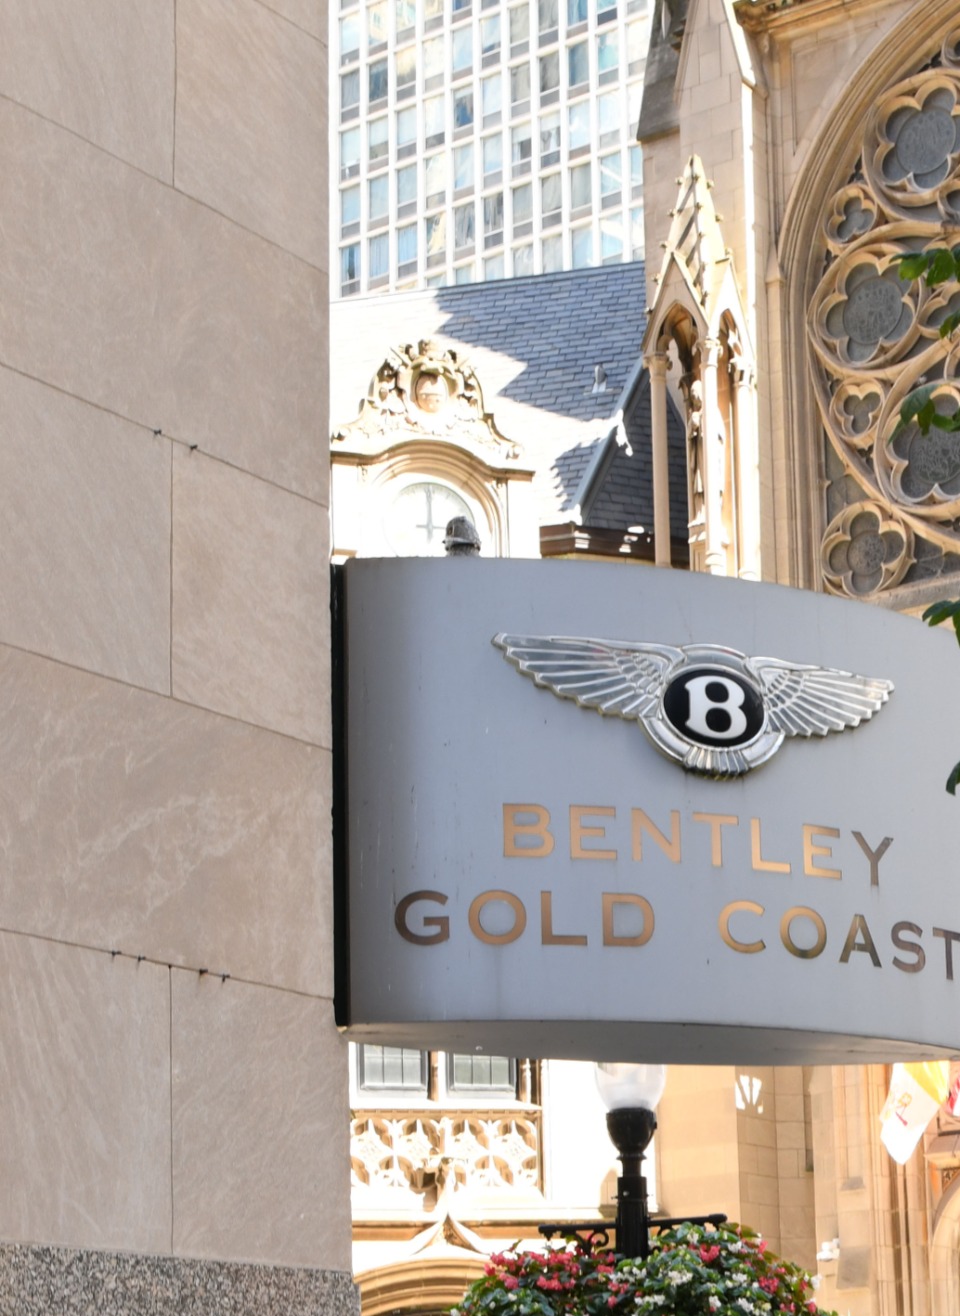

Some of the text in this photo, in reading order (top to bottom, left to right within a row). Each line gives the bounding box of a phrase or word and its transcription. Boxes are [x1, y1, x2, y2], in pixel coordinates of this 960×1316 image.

[685, 675, 746, 739] B
[502, 802, 894, 886] BENTLEY
[394, 889, 656, 948] GOLD
